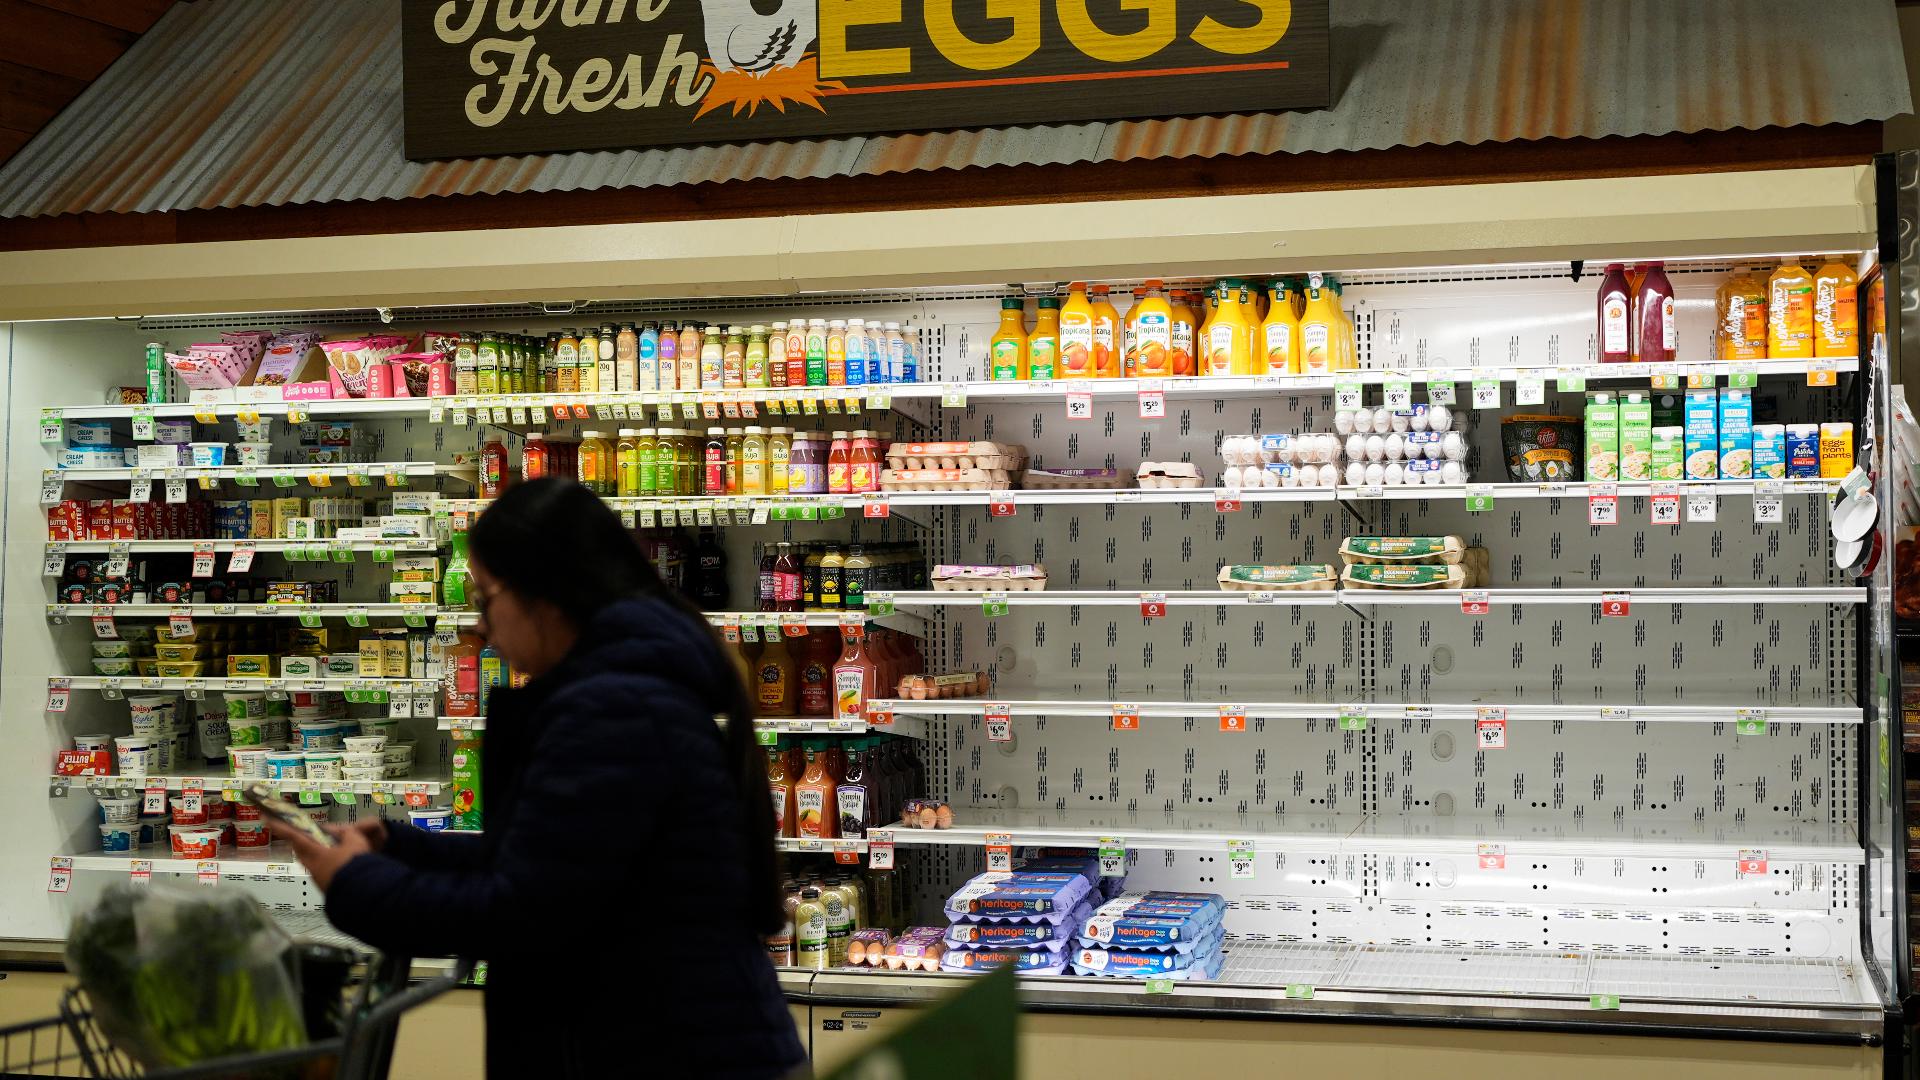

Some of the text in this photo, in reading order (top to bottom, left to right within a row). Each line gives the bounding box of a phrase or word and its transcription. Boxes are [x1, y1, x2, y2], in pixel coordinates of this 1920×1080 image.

[819, 0, 1292, 78] EGGS
[465, 34, 714, 127] Fresh
[1060, 327, 1089, 336] Tropicana
[1139, 326, 1168, 335] Tropicana
[661, 362, 672, 370] 20g
[342, 372, 366, 382] Sweet
[1338, 394, 1356, 404] $899
[1431, 390, 1448, 399] $899
[1069, 402, 1086, 412] $529
[1822, 440, 1846, 448] Eggs
[658, 452, 673, 460] suja
[774, 452, 788, 460] suja
[1822, 452, 1852, 460] plants
[1593, 506, 1611, 516] $799
[1655, 506, 1673, 516] $449
[1691, 504, 1709, 515] $699
[1758, 505, 1776, 515] $399
[131, 704, 153, 714] Daisy
[132, 715, 154, 724] Light
[64, 755, 89, 764] BUTTER
[799, 790, 820, 801] Simply
[839, 792, 861, 802] Simply
[873, 852, 888, 862] $599
[991, 854, 1006, 865] $999
[1234, 862, 1251, 873] $999
[980, 898, 1024, 910] heritage
[980, 928, 1025, 938] heritage
[1117, 927, 1156, 938] heritage
[975, 953, 1019, 964] heritage
[1111, 954, 1150, 966] heritage
